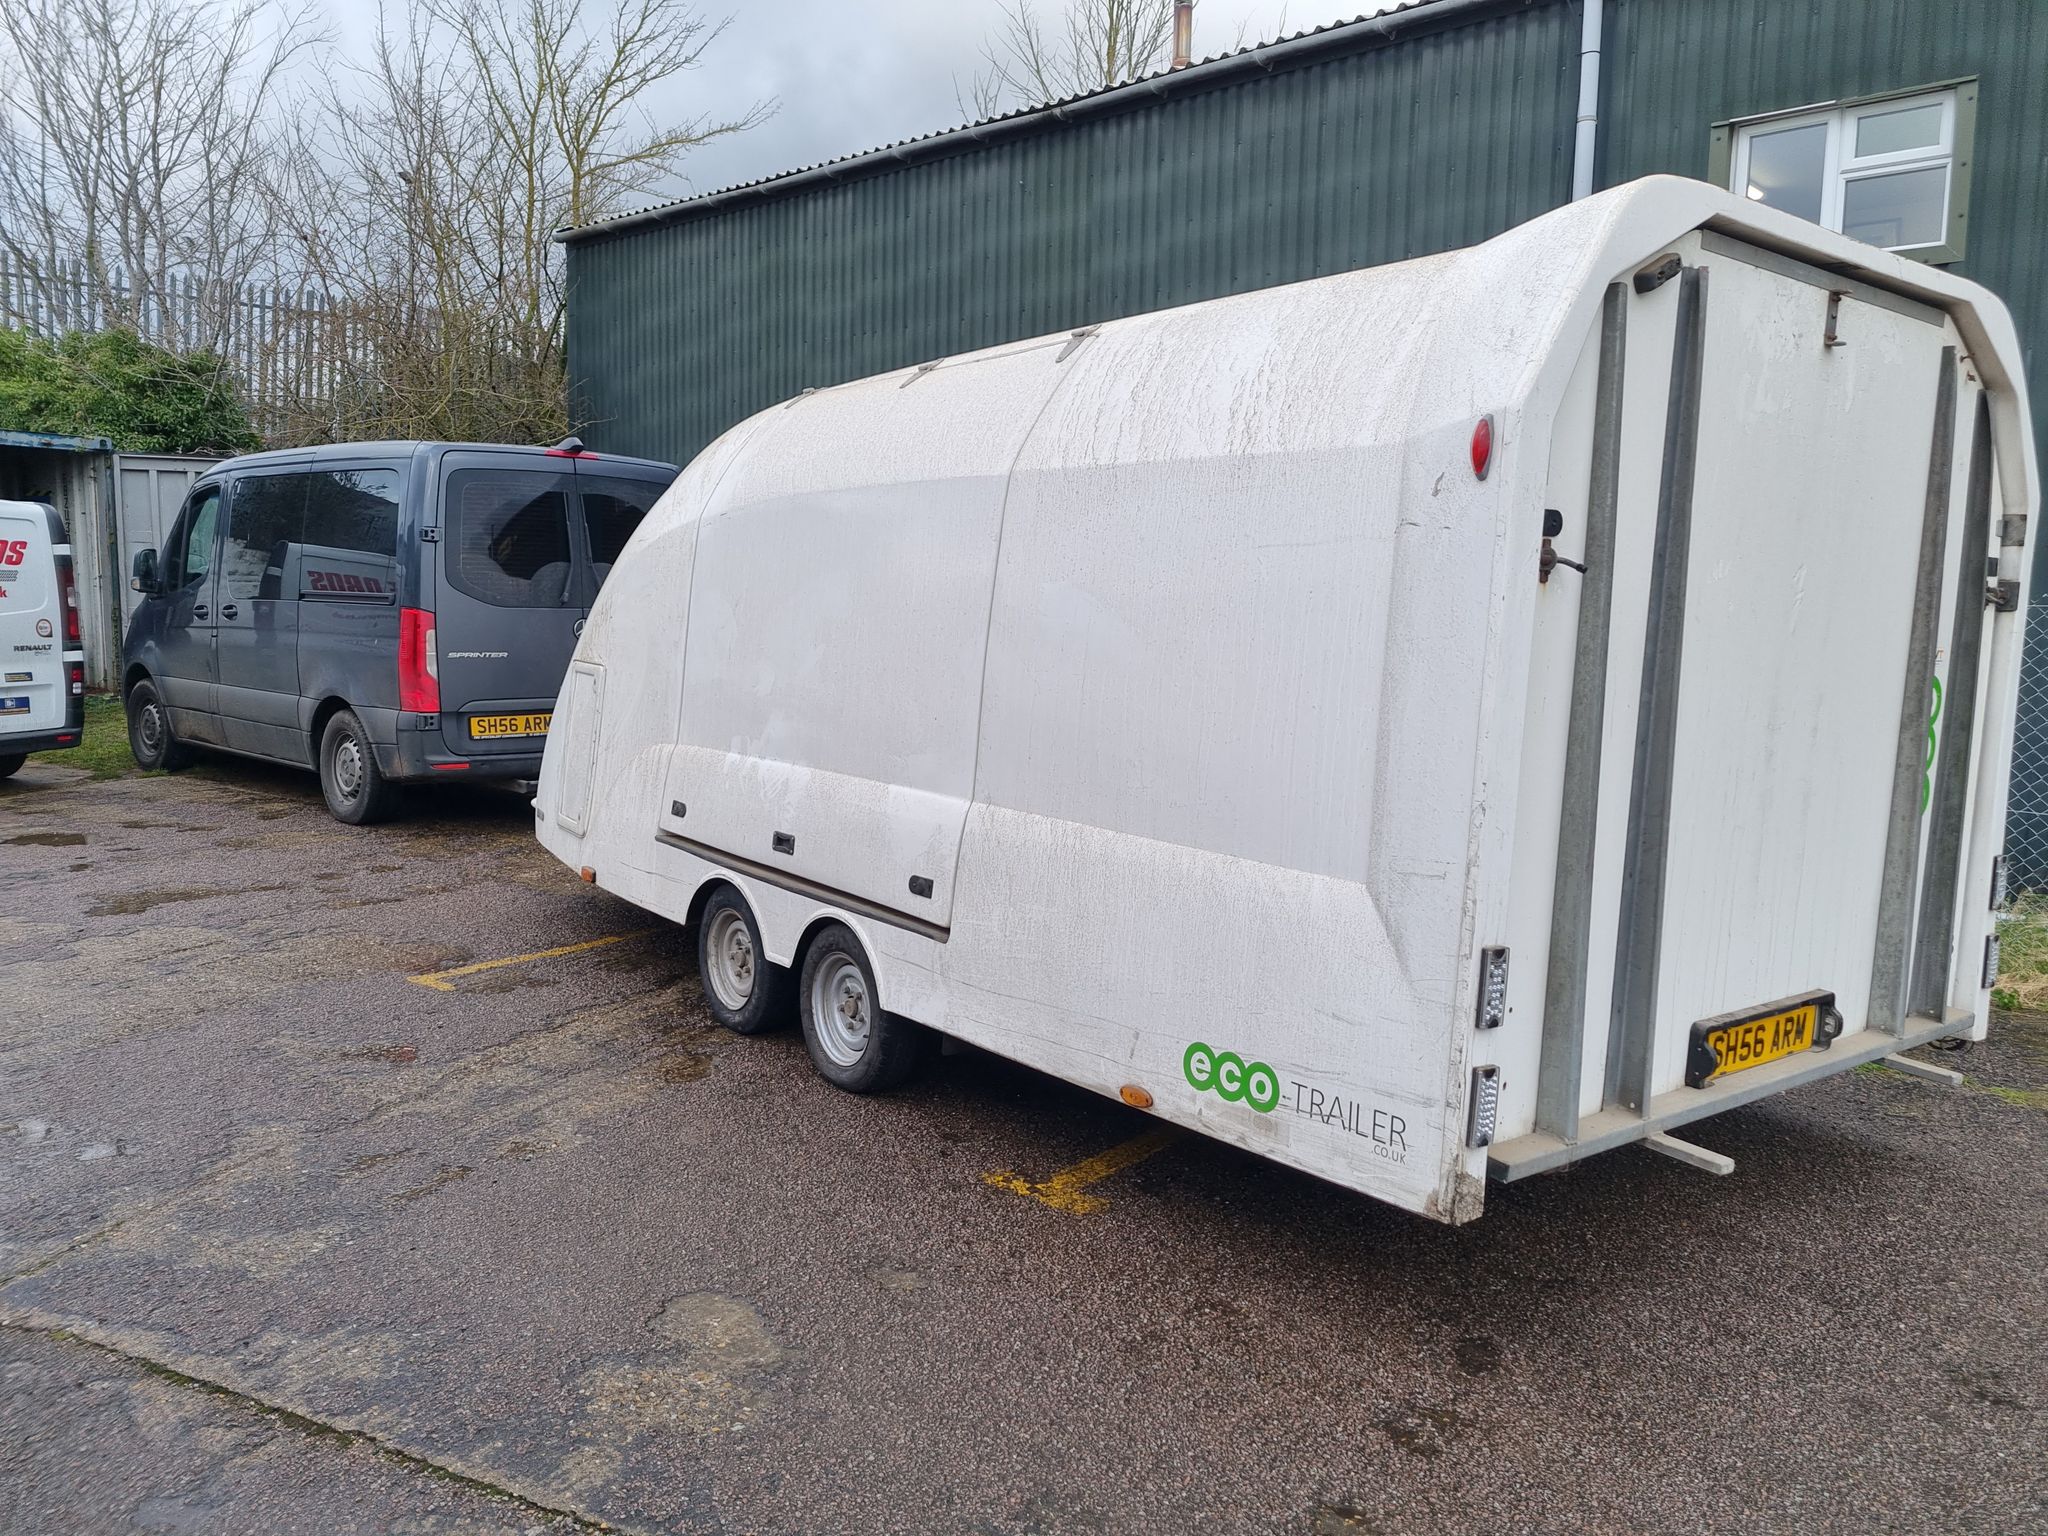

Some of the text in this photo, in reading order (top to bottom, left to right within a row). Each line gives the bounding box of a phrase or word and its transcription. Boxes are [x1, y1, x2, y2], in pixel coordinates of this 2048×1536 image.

[13, 644, 53, 652] RENAULT
[477, 718, 519, 733] SH56
[1714, 1012, 1807, 1068] SH56 ARM
